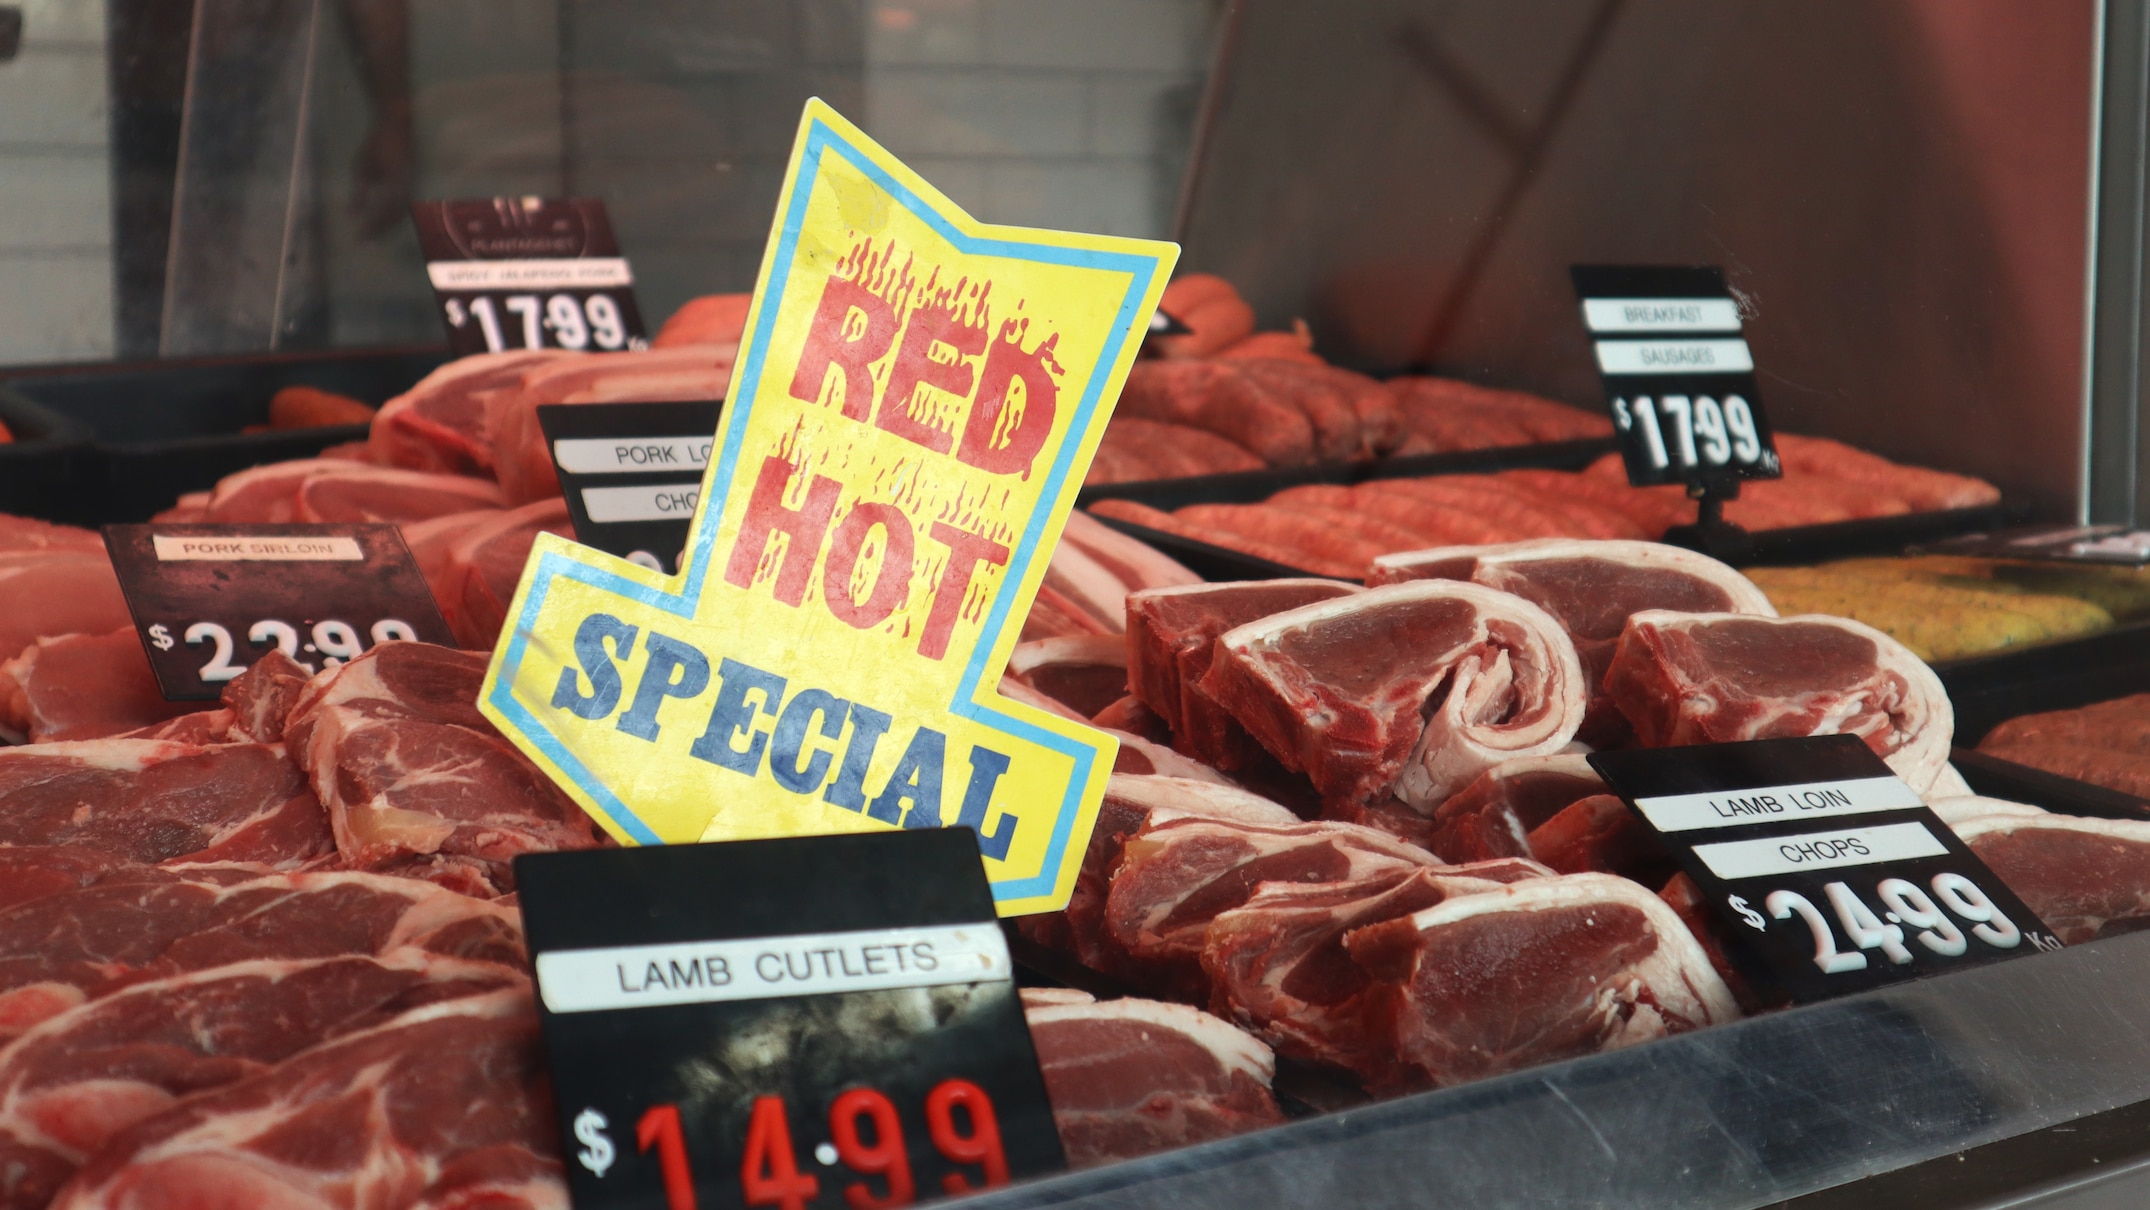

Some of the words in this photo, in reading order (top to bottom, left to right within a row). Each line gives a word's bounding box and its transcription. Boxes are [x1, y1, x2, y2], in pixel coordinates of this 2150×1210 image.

[1623, 305, 1703, 324] BREAKFAST
[789, 252, 1064, 480] RED
[1639, 346, 1716, 366] SAUSAGES
[615, 445, 678, 465] PORK
[182, 542, 246, 555] PORK
[249, 542, 335, 555] SIRLOIN
[723, 440, 1011, 662] HOT
[550, 612, 1019, 863] SPECIAL
[1709, 794, 1785, 819] LAMB
[1789, 788, 1853, 811] LOIN
[1779, 837, 1871, 864] CHOPS
[615, 955, 733, 994] LAMB
[755, 941, 940, 984] CUTLETS
